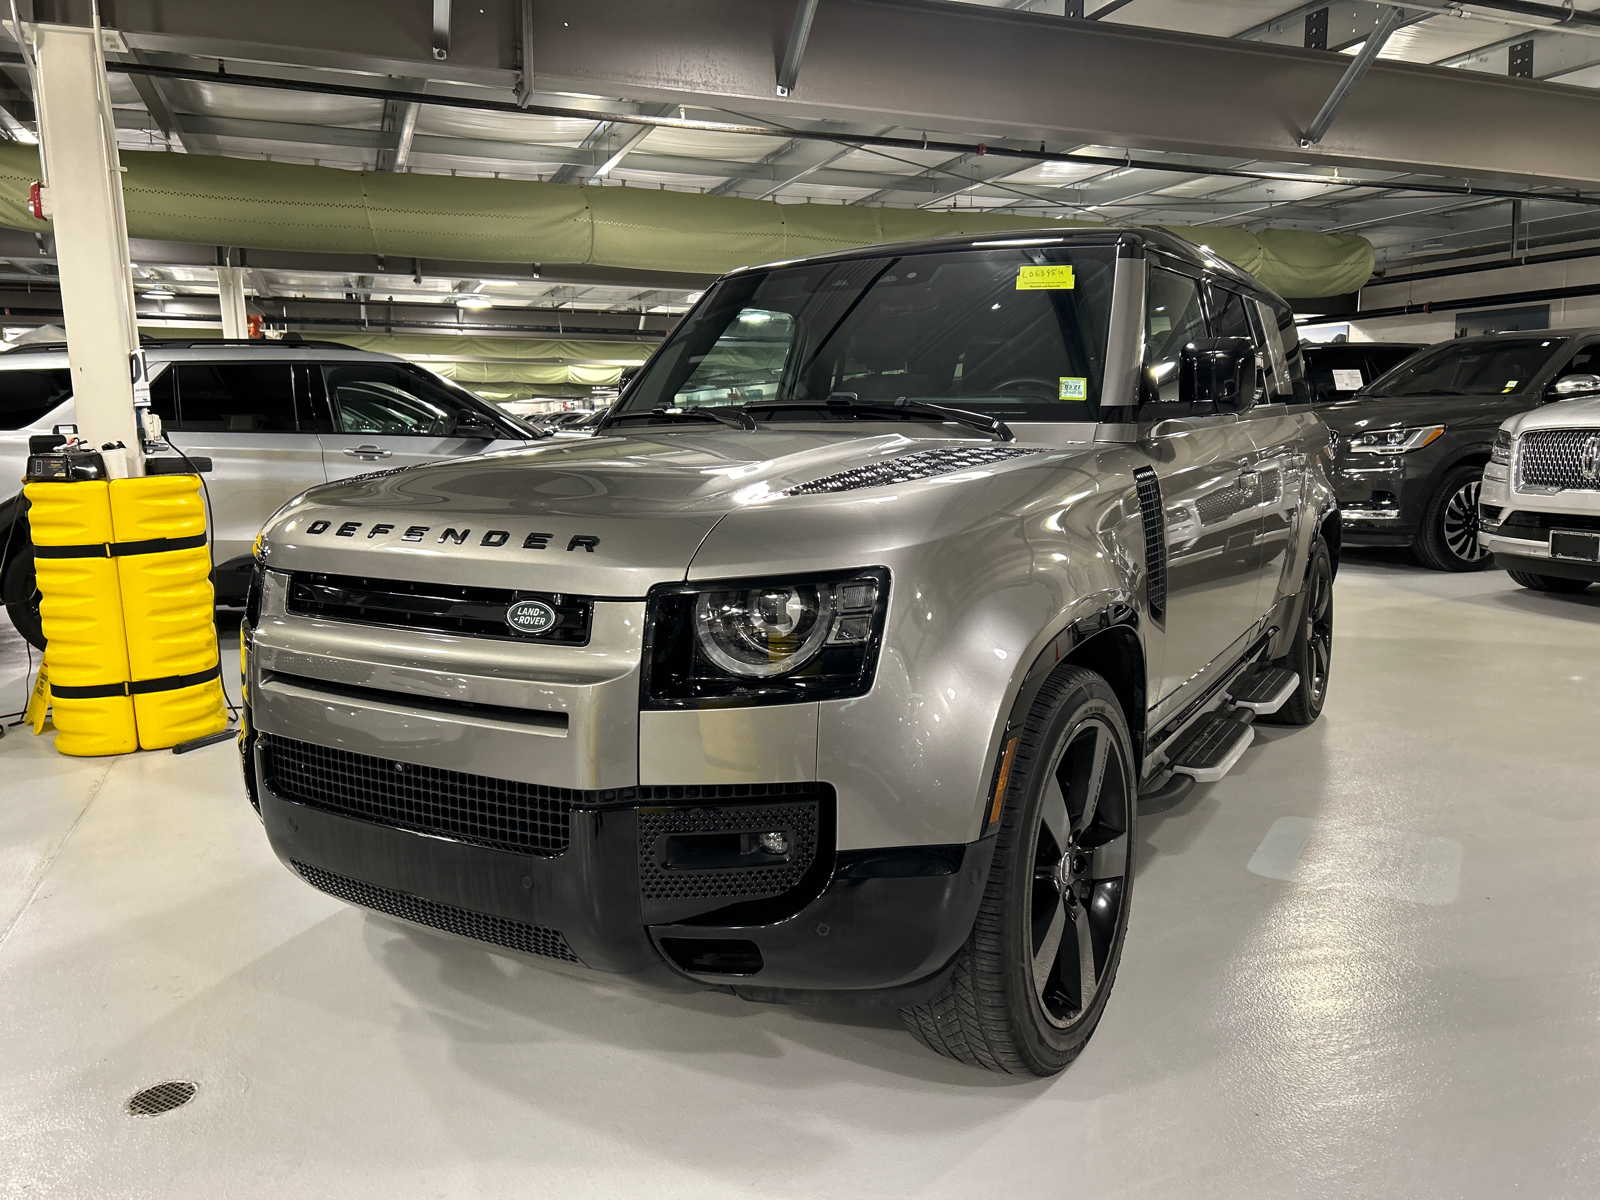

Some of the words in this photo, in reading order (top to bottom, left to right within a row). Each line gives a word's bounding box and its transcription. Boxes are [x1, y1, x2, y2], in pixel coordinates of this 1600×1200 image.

[305, 519, 600, 553] DEFENDER
[517, 607, 540, 616] LAND
[518, 616, 546, 626] ROVER
